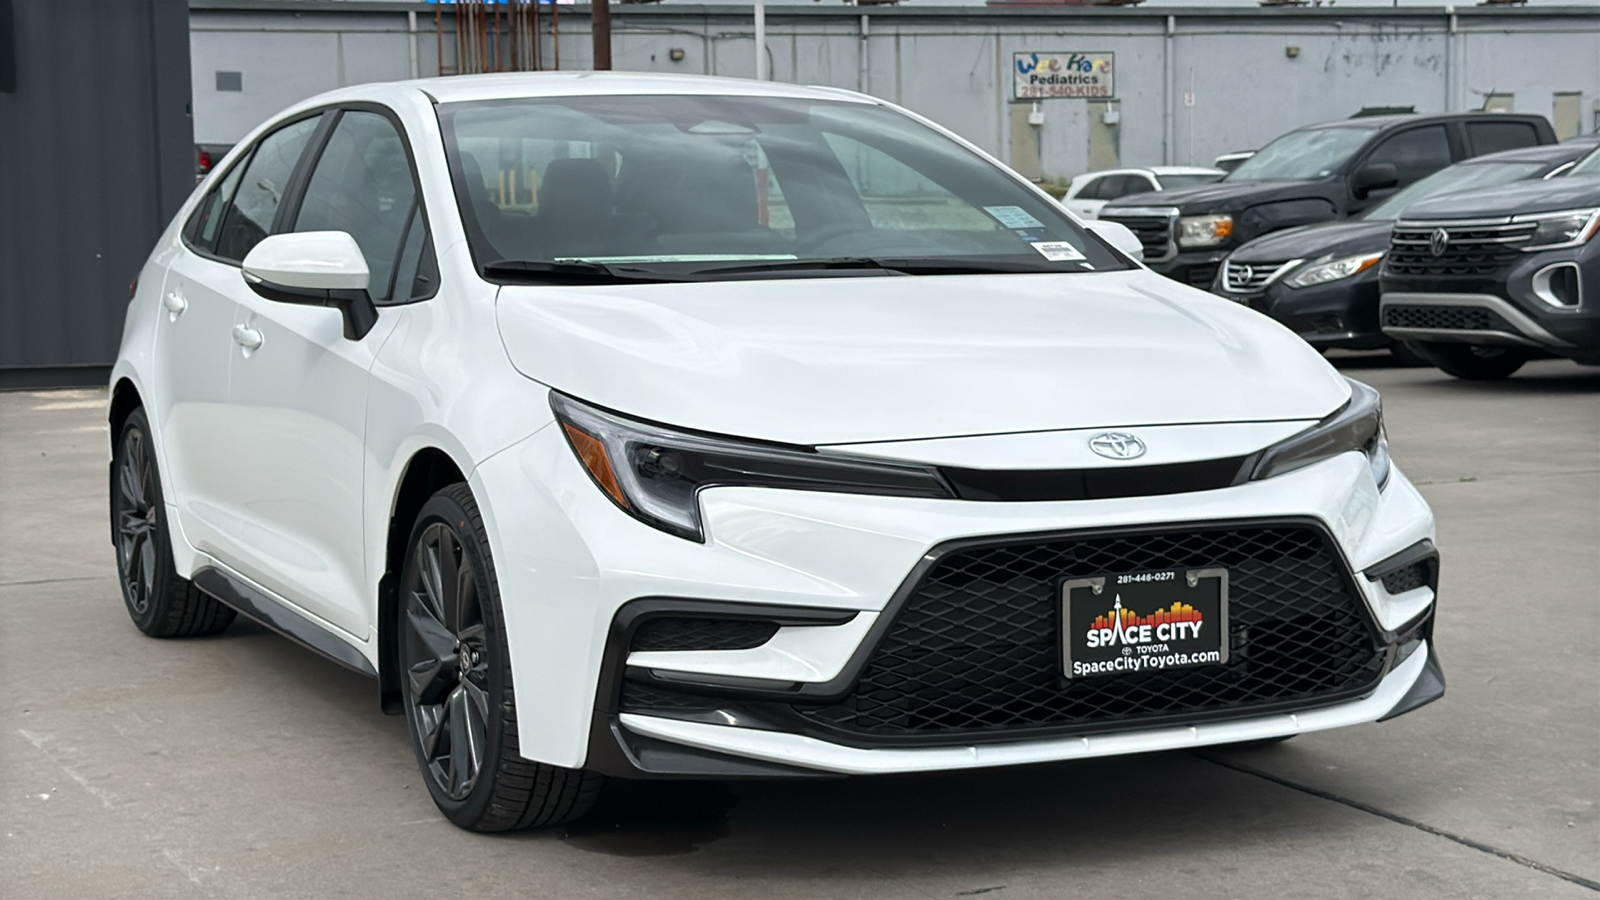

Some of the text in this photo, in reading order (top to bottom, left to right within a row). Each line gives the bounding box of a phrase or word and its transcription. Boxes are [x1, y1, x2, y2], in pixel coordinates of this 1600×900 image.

[1017, 53, 1111, 74] Wee Kare
[1030, 74, 1098, 85] Pediatrics
[1117, 572, 1175, 584] 281-446-0271
[1086, 620, 1203, 648] SPACE CITY
[1136, 643, 1169, 654] TOYOTA
[1073, 650, 1220, 676] SpaceCityToyota.com
